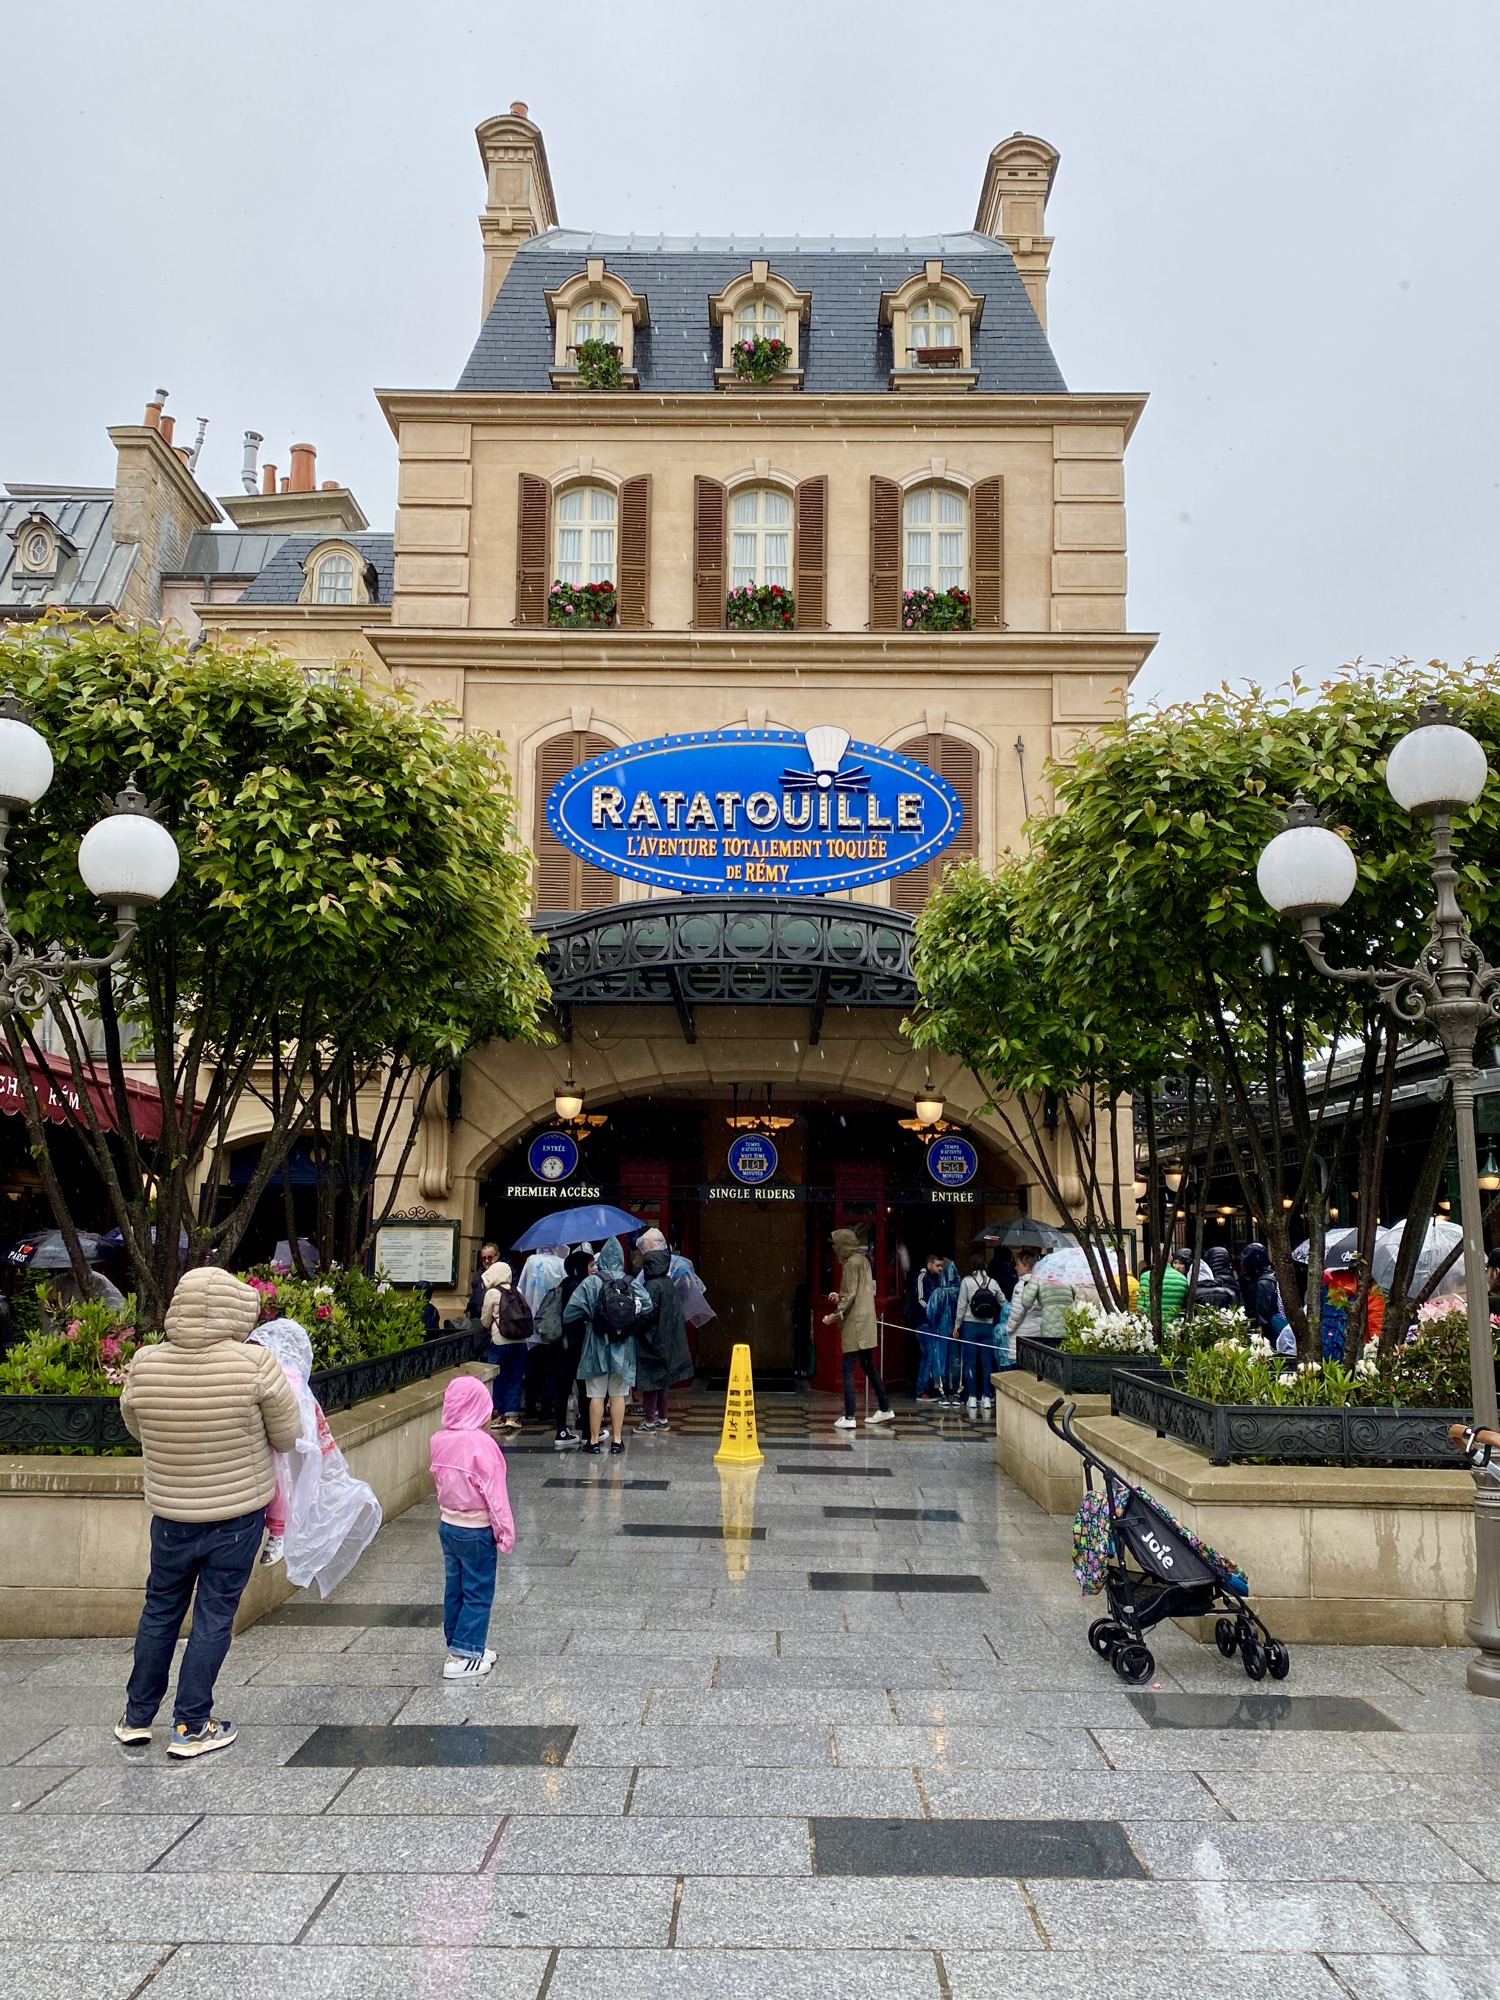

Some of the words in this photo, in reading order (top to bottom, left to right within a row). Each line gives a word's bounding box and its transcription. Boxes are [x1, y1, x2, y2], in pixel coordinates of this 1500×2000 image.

[591, 785, 924, 832] RATATOUILLE
[626, 835, 718, 858] L'AVENTURE
[721, 837, 822, 859] TOTALEMENT
[826, 833, 888, 860] TOQUÉE
[726, 865, 742, 880] DE
[745, 857, 790, 884] RÉMY
[543, 1144, 566, 1152] ENTRÉE
[507, 1186, 557, 1198] PREMIER
[559, 1186, 600, 1198] ACCESS
[709, 1188, 751, 1199] SINGLE
[754, 1188, 796, 1200] RIDERS
[931, 1191, 974, 1202] ENTRÉE
[7, 1251, 28, 1262] PARIS
[1141, 1531, 1174, 1570] Joie
